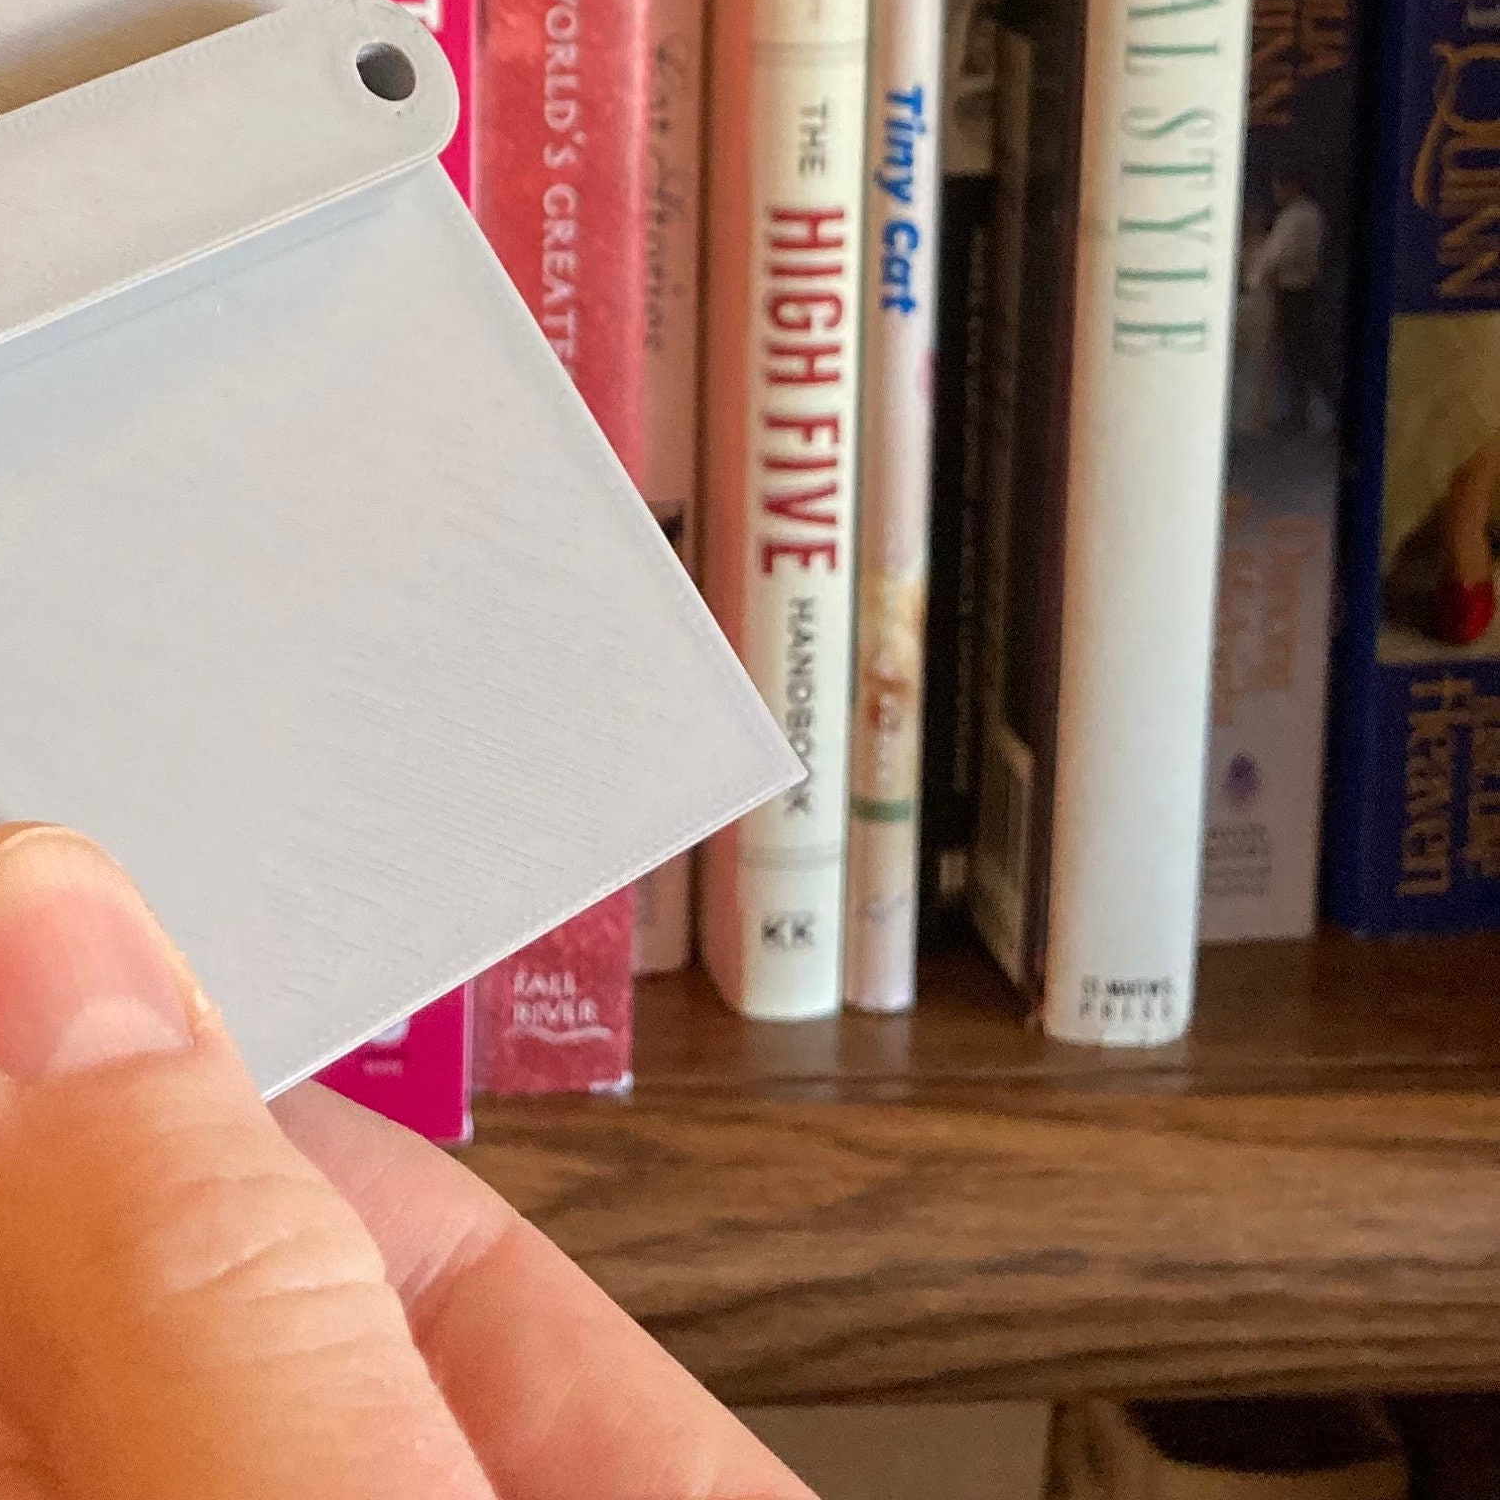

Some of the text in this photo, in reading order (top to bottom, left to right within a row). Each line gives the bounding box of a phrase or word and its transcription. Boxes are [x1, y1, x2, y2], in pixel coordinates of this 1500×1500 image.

[799, 102, 829, 177] THE
[876, 86, 924, 316] Tiny Cat
[766, 206, 847, 388] HIGH
[1111, 104, 1219, 358] STYLE
[761, 413, 841, 578] FIVE
[760, 912, 816, 950] KK
